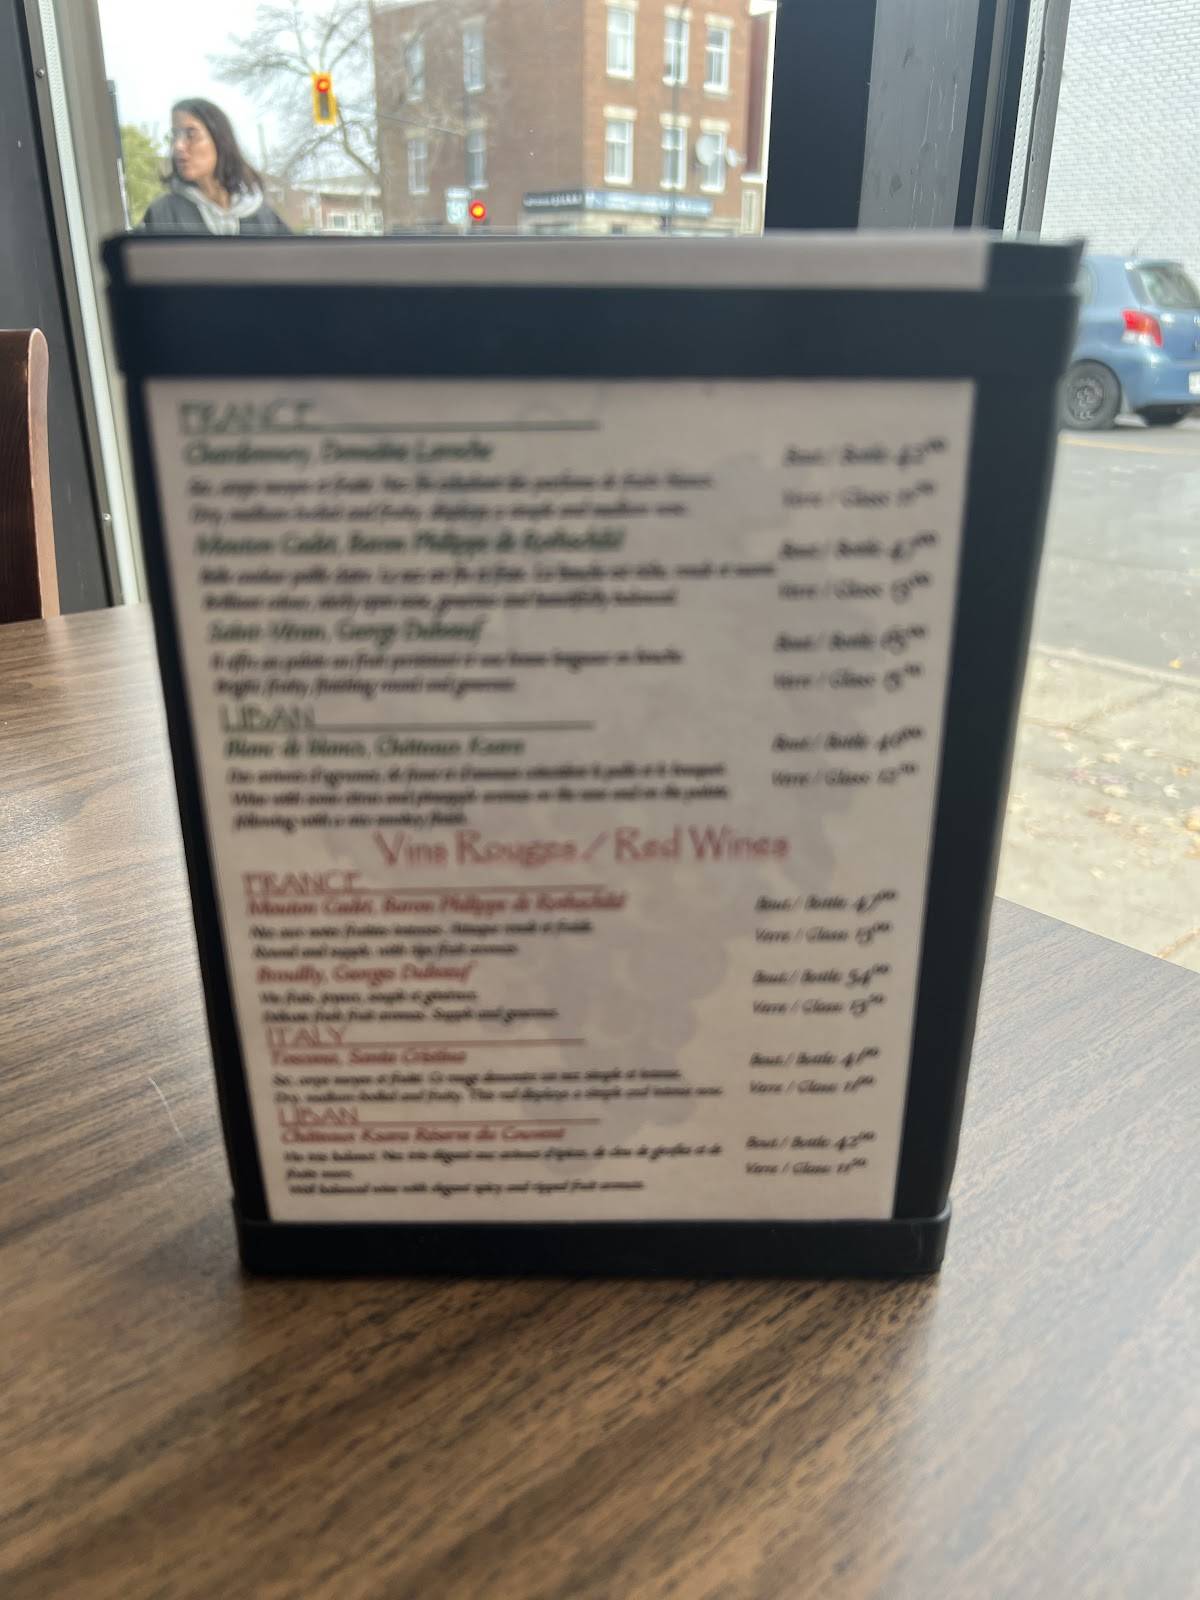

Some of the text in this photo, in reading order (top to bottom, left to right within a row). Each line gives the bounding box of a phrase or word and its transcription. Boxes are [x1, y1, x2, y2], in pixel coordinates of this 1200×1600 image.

[181, 400, 313, 432] FRANCE
[221, 703, 316, 732] LIBAN
[375, 830, 446, 865] Vins
[458, 829, 577, 867] Rouges
[616, 824, 681, 861] Red
[690, 823, 789, 861] Wines
[245, 870, 361, 896] FRANCE
[268, 1025, 347, 1049] ITALY
[279, 1107, 360, 1127] LIBAN
